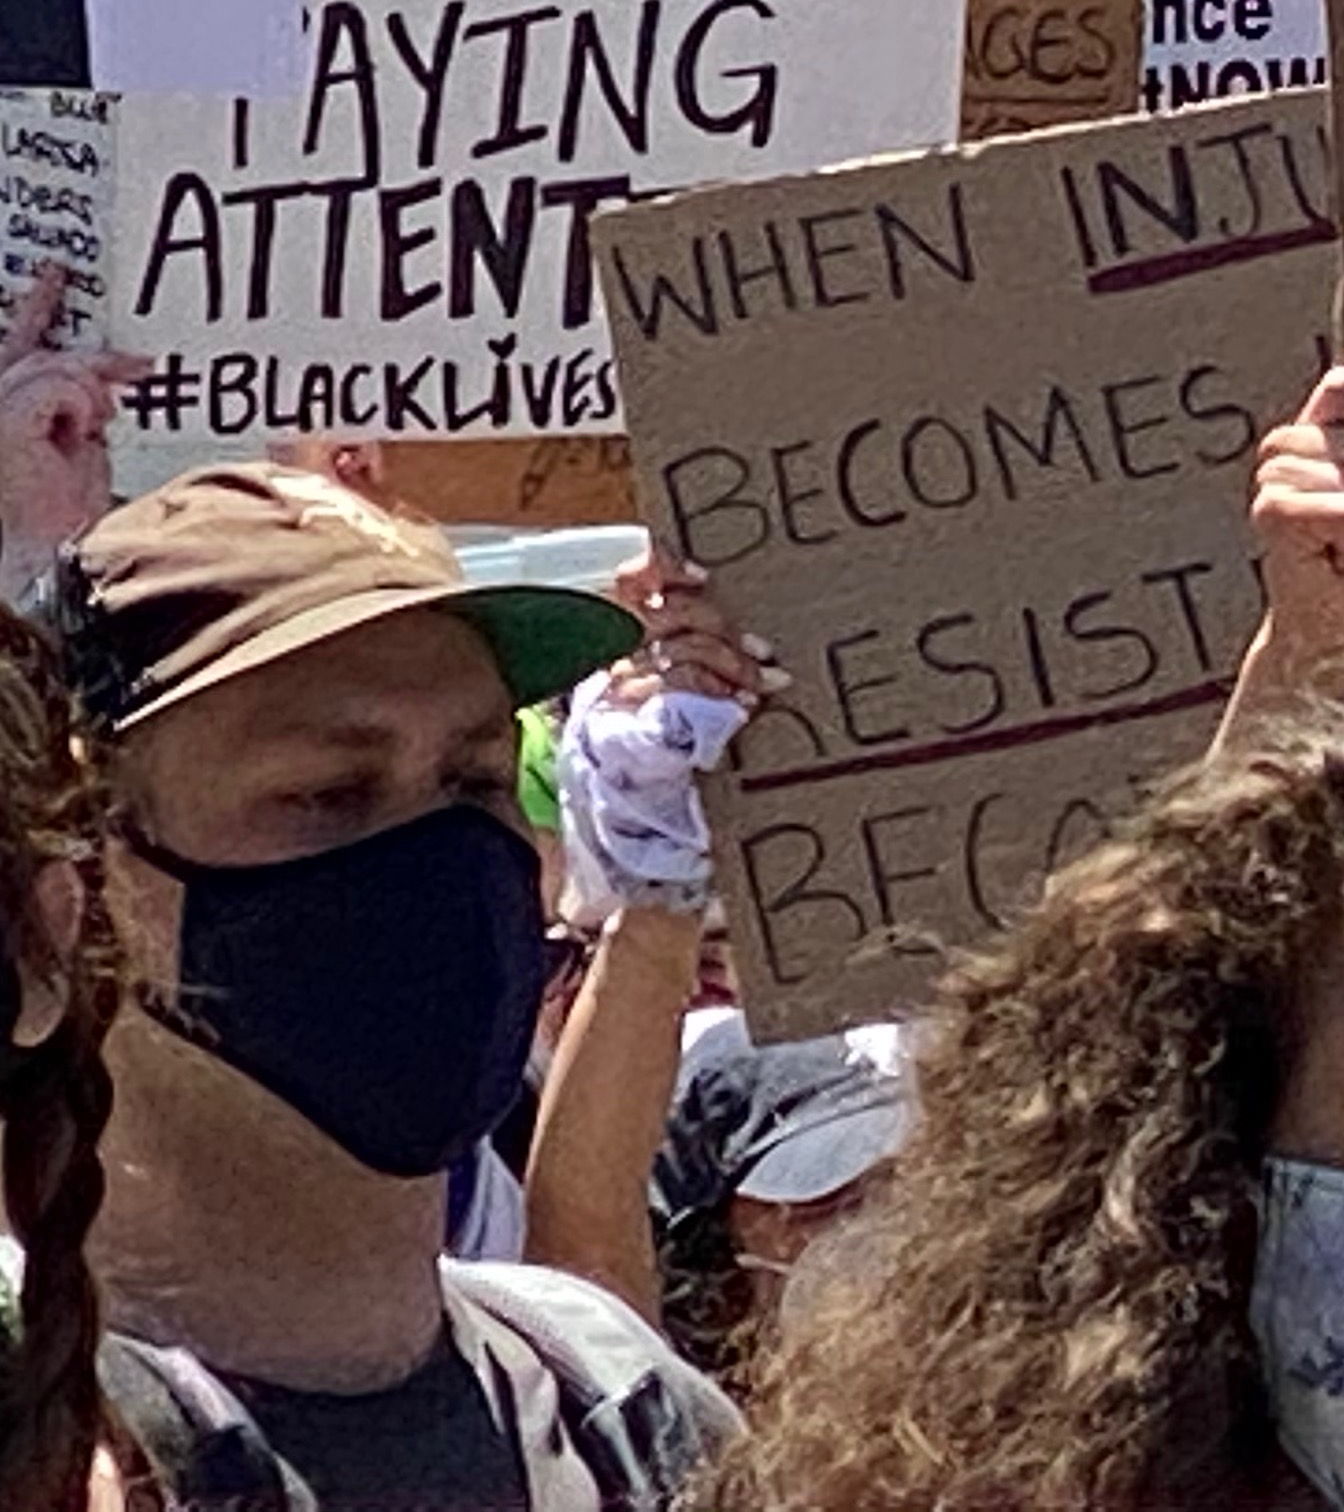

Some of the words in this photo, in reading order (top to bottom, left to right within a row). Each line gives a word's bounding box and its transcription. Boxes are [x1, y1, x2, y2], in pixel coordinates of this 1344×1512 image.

[965, 6, 1116, 84] GES
[134, 173, 673, 330] ATTENT
[613, 182, 976, 342] WHEN
[664, 364, 1256, 566] BECOMES
